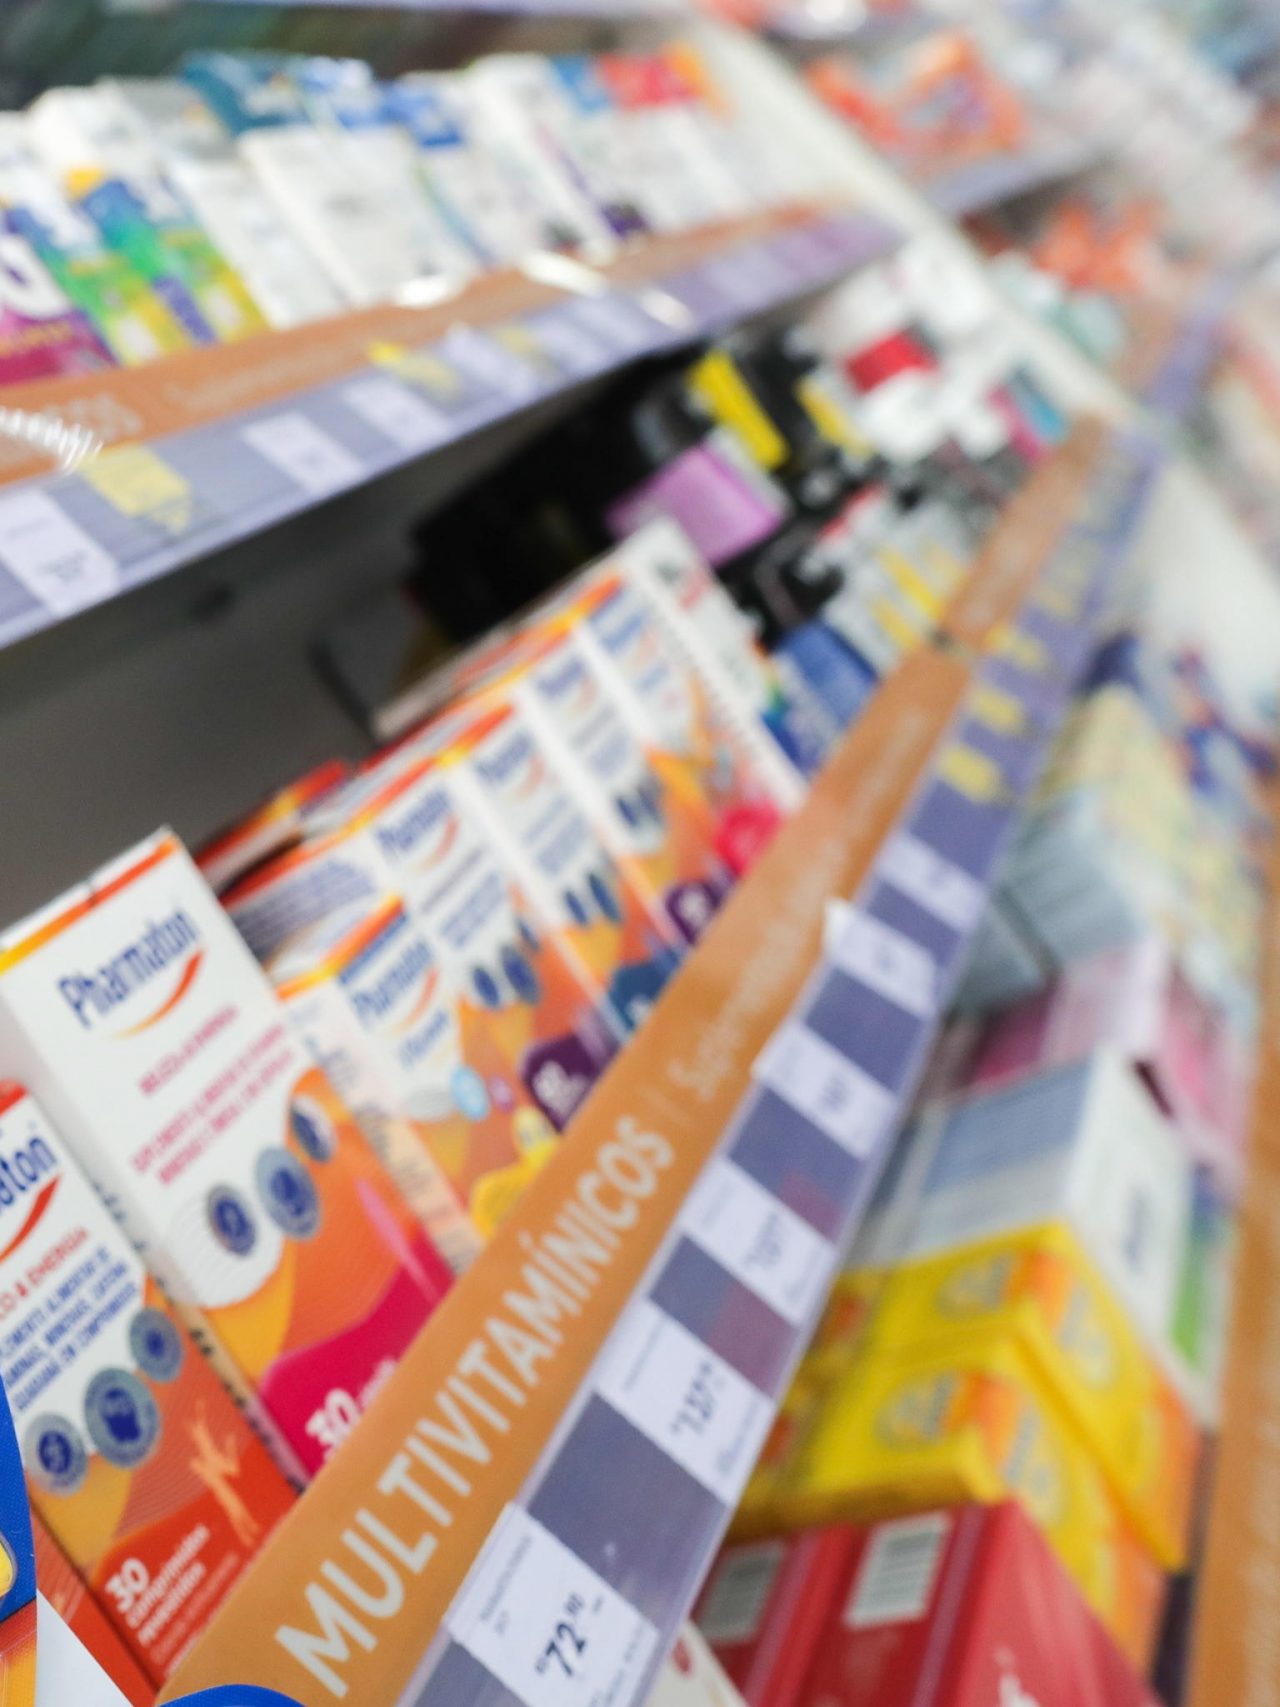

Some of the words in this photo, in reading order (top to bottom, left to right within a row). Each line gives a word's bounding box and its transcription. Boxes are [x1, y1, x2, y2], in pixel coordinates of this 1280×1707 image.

[58, 907, 199, 1031] Pharmaton
[274, 1115, 674, 1698] MULTIVITAMÍNICOS
[104, 1557, 150, 1614] 30
